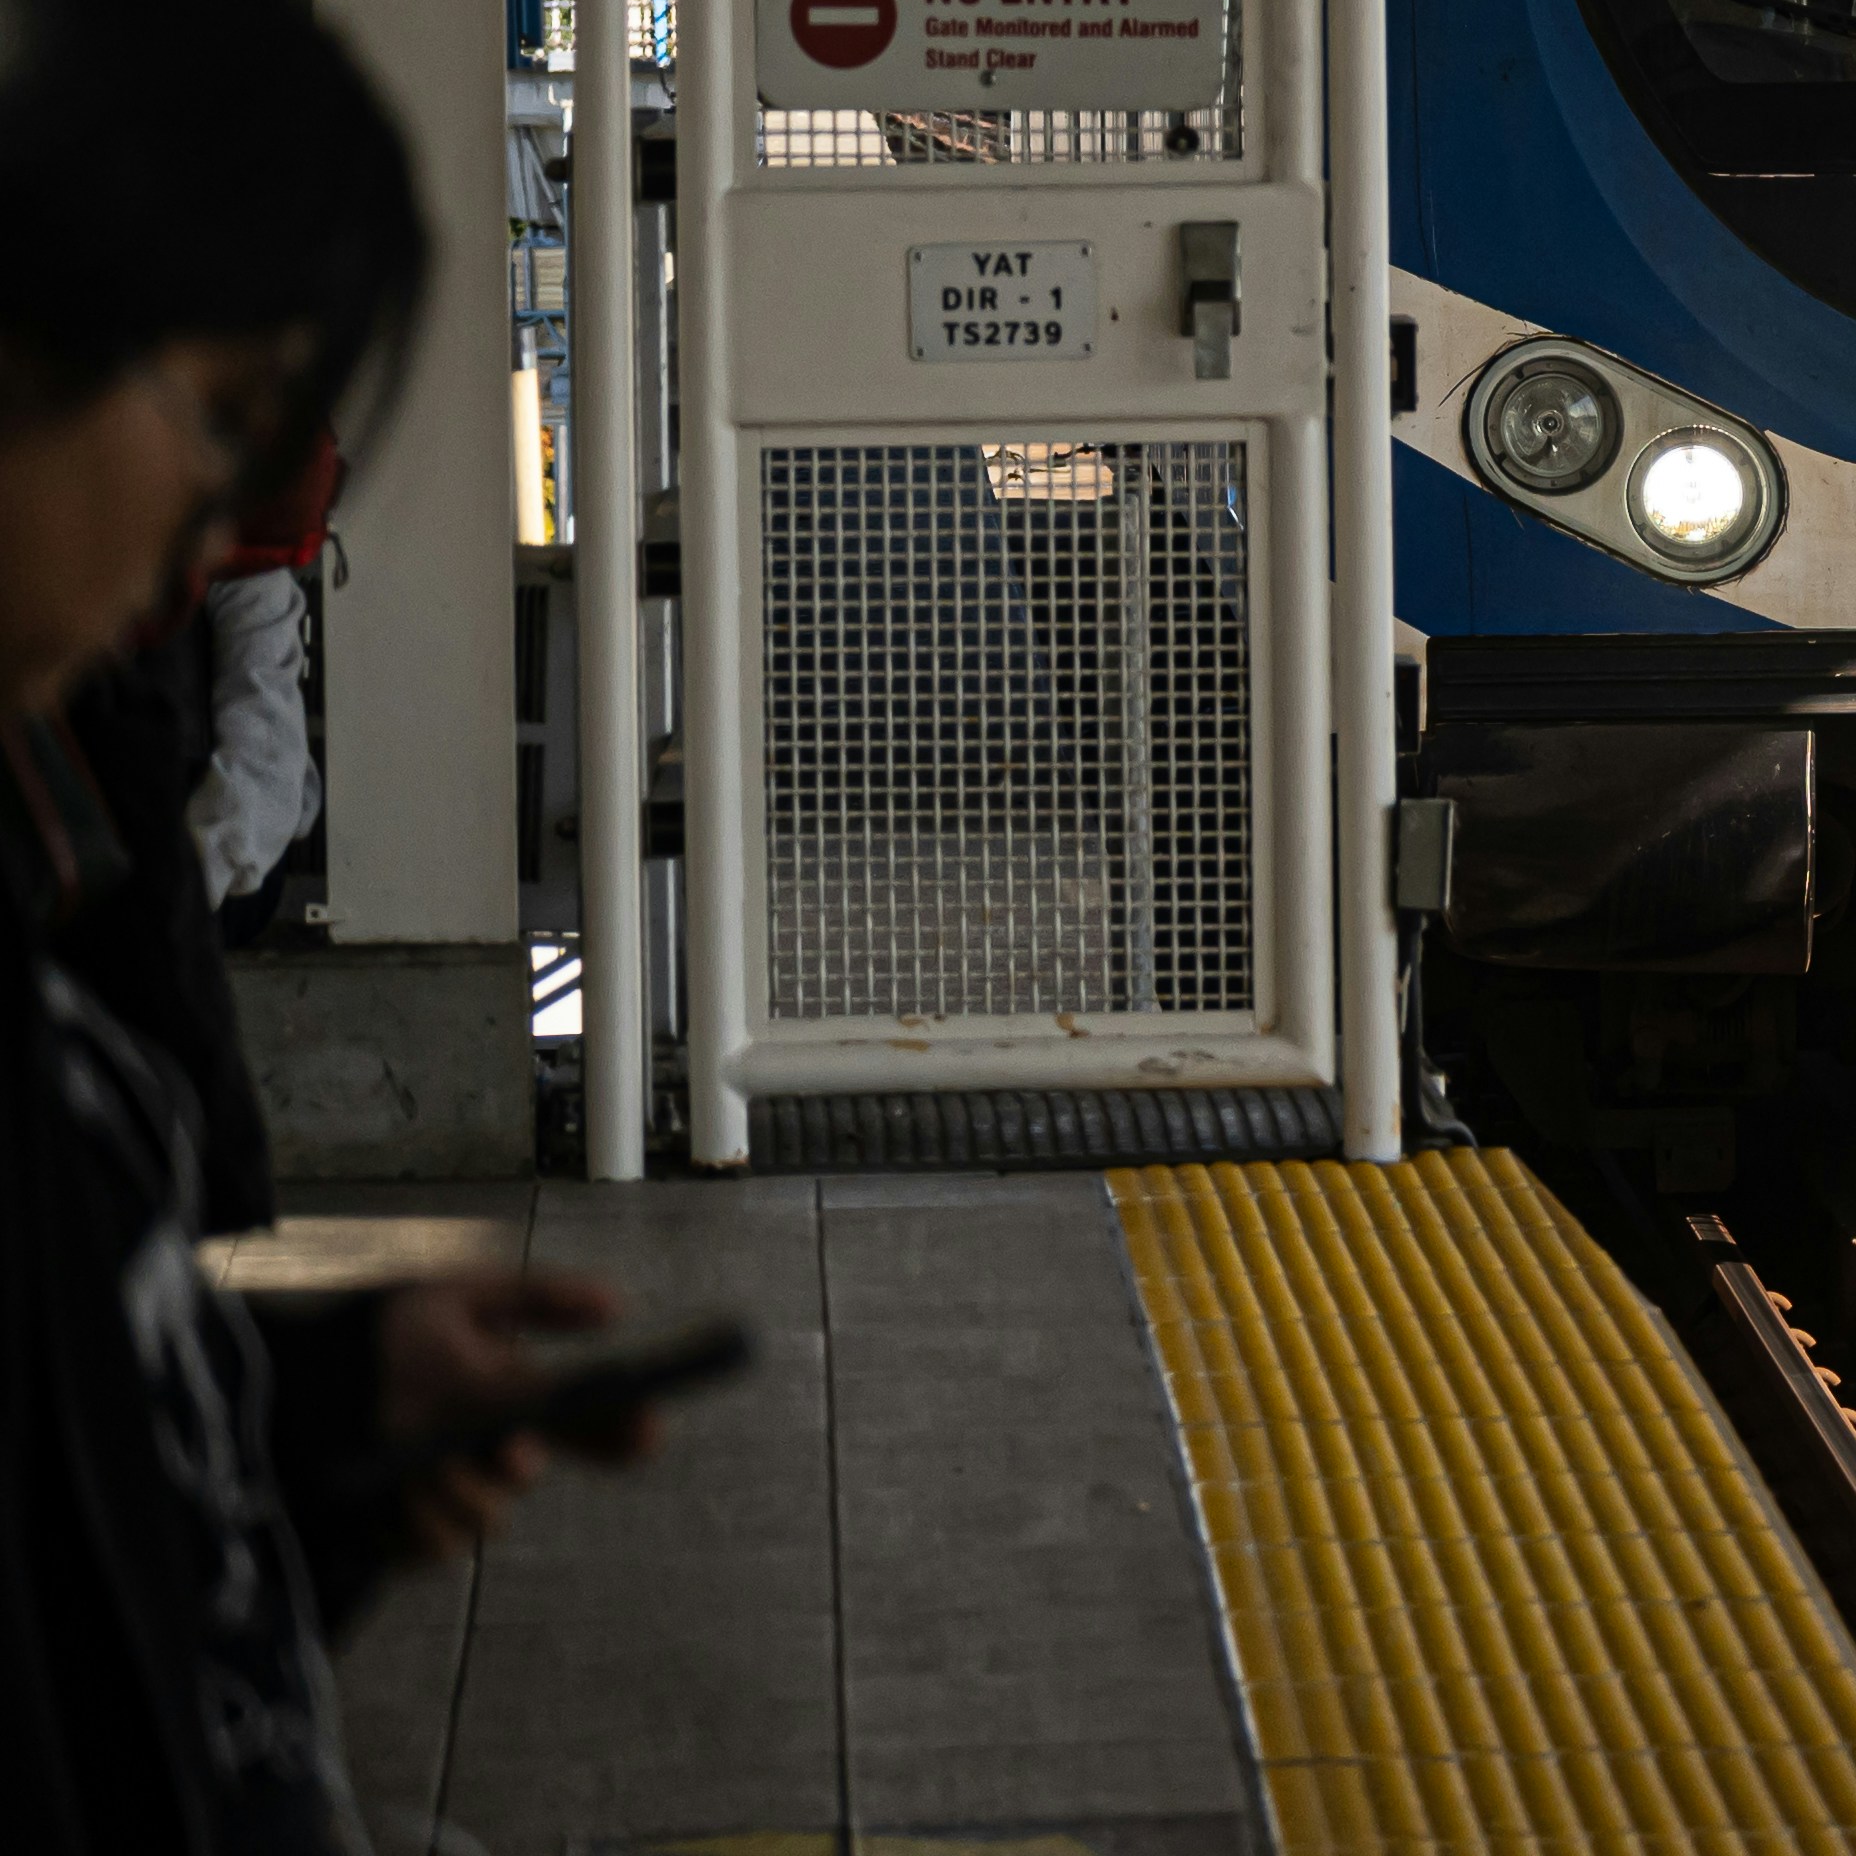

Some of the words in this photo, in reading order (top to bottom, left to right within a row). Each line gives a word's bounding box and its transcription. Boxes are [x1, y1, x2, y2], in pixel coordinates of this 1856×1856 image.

[925, 17, 969, 37] Gate
[975, 17, 1072, 37] Monitored
[1078, 18, 1113, 37] and
[1119, 17, 1200, 37] Alarmed
[925, 48, 980, 69] Stand
[986, 48, 1037, 69] Clear
[972, 252, 1032, 276] YAT
[942, 287, 998, 311] DIR
[1050, 286, 1062, 310] 1
[943, 321, 1062, 346] TS2739
